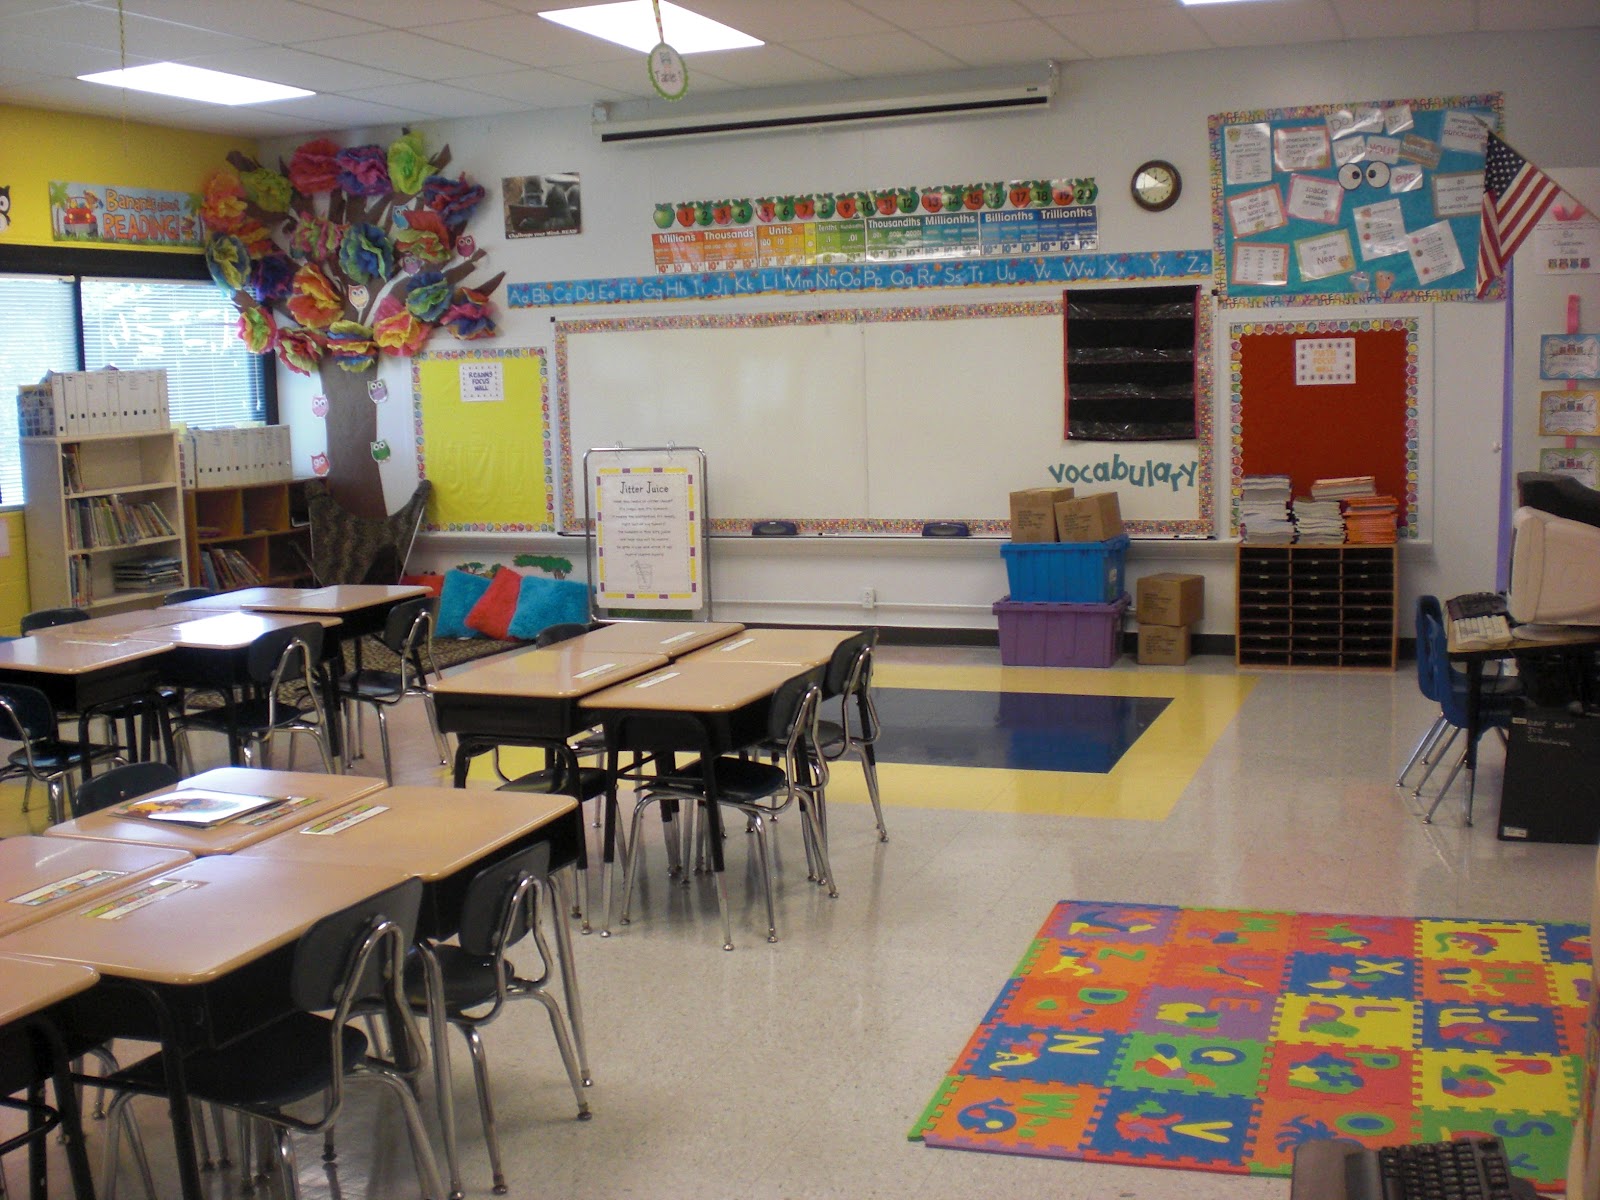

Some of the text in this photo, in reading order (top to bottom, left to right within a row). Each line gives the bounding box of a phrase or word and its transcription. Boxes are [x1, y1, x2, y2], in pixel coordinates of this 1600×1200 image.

[106, 189, 156, 212] Bananas
[685, 211, 689, 221] 1
[702, 210, 708, 221] 2
[720, 209, 726, 220] 3
[738, 208, 745, 219] 4
[783, 206, 790, 216] 6
[802, 205, 808, 215] 7
[844, 202, 850, 213] 9
[861, 200, 873, 211] 10
[903, 197, 912, 208] 12
[928, 196, 939, 207] 13
[1016, 191, 1026, 202] 17
[1036, 190, 1047, 201] 18
[1077, 189, 1092, 199] 20
[659, 233, 696, 244] Millions
[704, 229, 754, 240] Thousands
[768, 226, 793, 235] Units
[868, 218, 921, 229] Thousandths
[925, 214, 975, 226] Millionths
[985, 212, 1034, 223] Billionths
[1041, 208, 1093, 220] Trillionths
[510, 256, 1208, 304] Aa Bb Cc Dd Ee Ff Gg Hh Ii Jj Kk Ll Mm Nn Oo Pp Qq Rr Ss Tt Uu Vv Ww Xx Yy Zz
[1047, 453, 1198, 492] vocabulary
[619, 481, 669, 494] Jitter Juice
[1356, 960, 1404, 975] X
[1484, 968, 1536, 984] H
[1345, 1052, 1400, 1070] P
[1495, 1058, 1552, 1075] R
[1171, 1121, 1233, 1143] V
[1493, 1119, 1555, 1138] S
